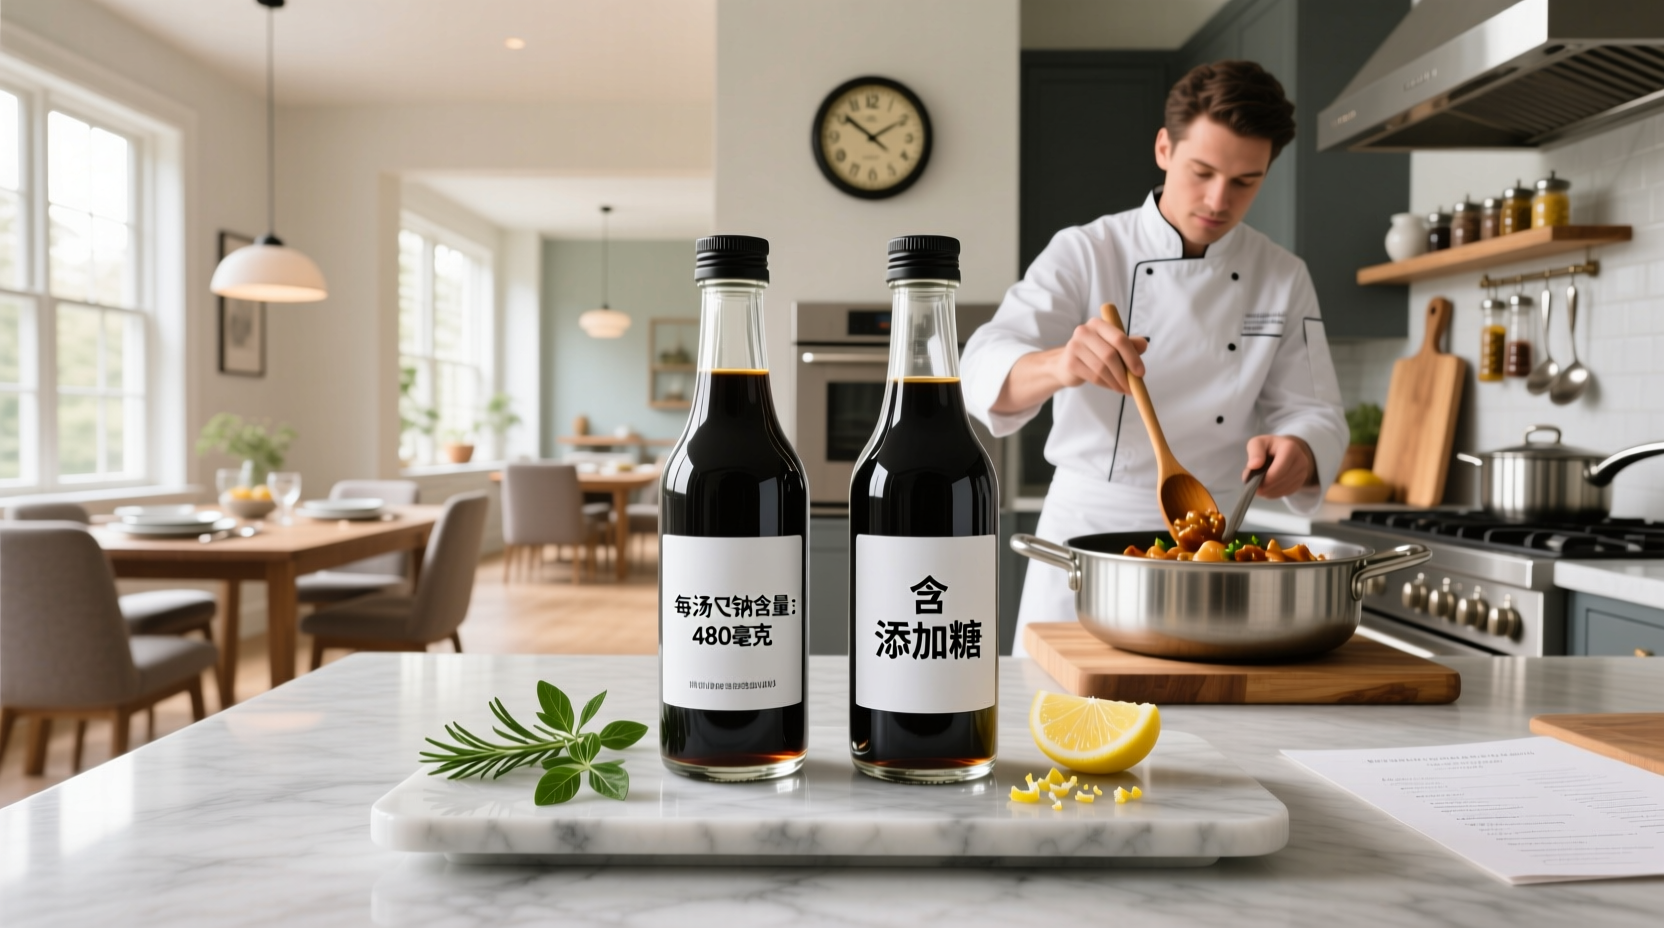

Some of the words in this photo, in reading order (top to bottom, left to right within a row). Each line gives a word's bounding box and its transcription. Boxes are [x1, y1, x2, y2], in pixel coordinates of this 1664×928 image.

[865, 93, 879, 109] 12
[909, 574, 949, 615] 含
[692, 622, 773, 648] 480毫克
[874, 619, 983, 660] 添加糖
